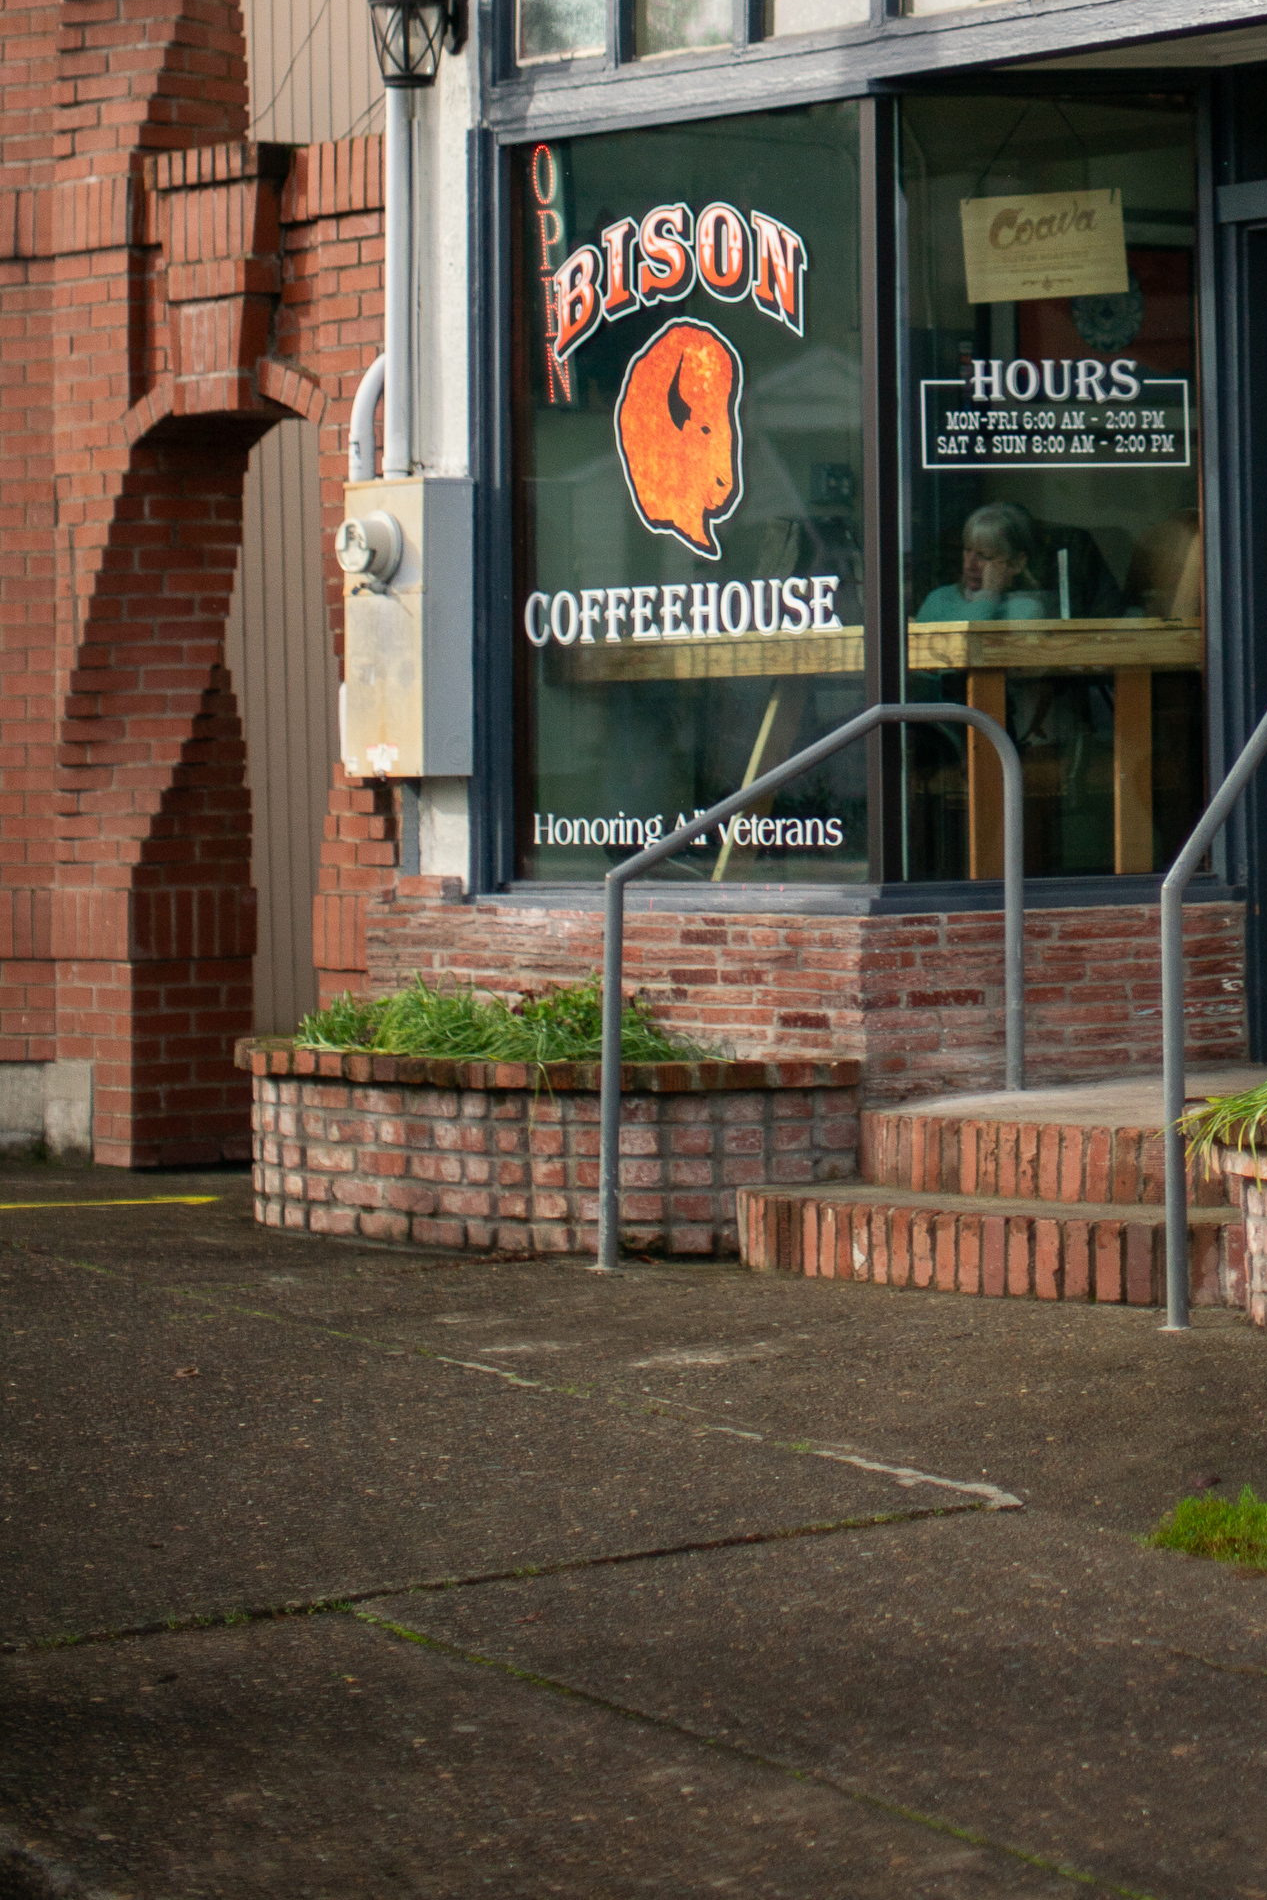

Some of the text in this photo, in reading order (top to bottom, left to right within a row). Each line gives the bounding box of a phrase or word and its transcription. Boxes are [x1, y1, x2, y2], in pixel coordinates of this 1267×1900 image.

[554, 201, 808, 363] BISON
[970, 359, 1141, 403] HOURS
[945, 411, 1018, 430] MON-FRI
[1022, 411, 1056, 430] 6:00
[1060, 411, 1085, 430] AM
[1105, 411, 1137, 429] 2:00
[1141, 411, 1165, 429] PM
[937, 435, 969, 454] SAT
[974, 436, 986, 454] &
[992, 436, 1027, 453] SUN
[1031, 435, 1066, 453] 8:00
[1069, 435, 1095, 453] AM
[1114, 435, 1146, 453] 2:00
[1150, 434, 1175, 452] PM
[524, 575, 844, 648] COFFEEHOUSE
[533, 810, 664, 851] Honoring
[717, 813, 844, 847] Veterans
